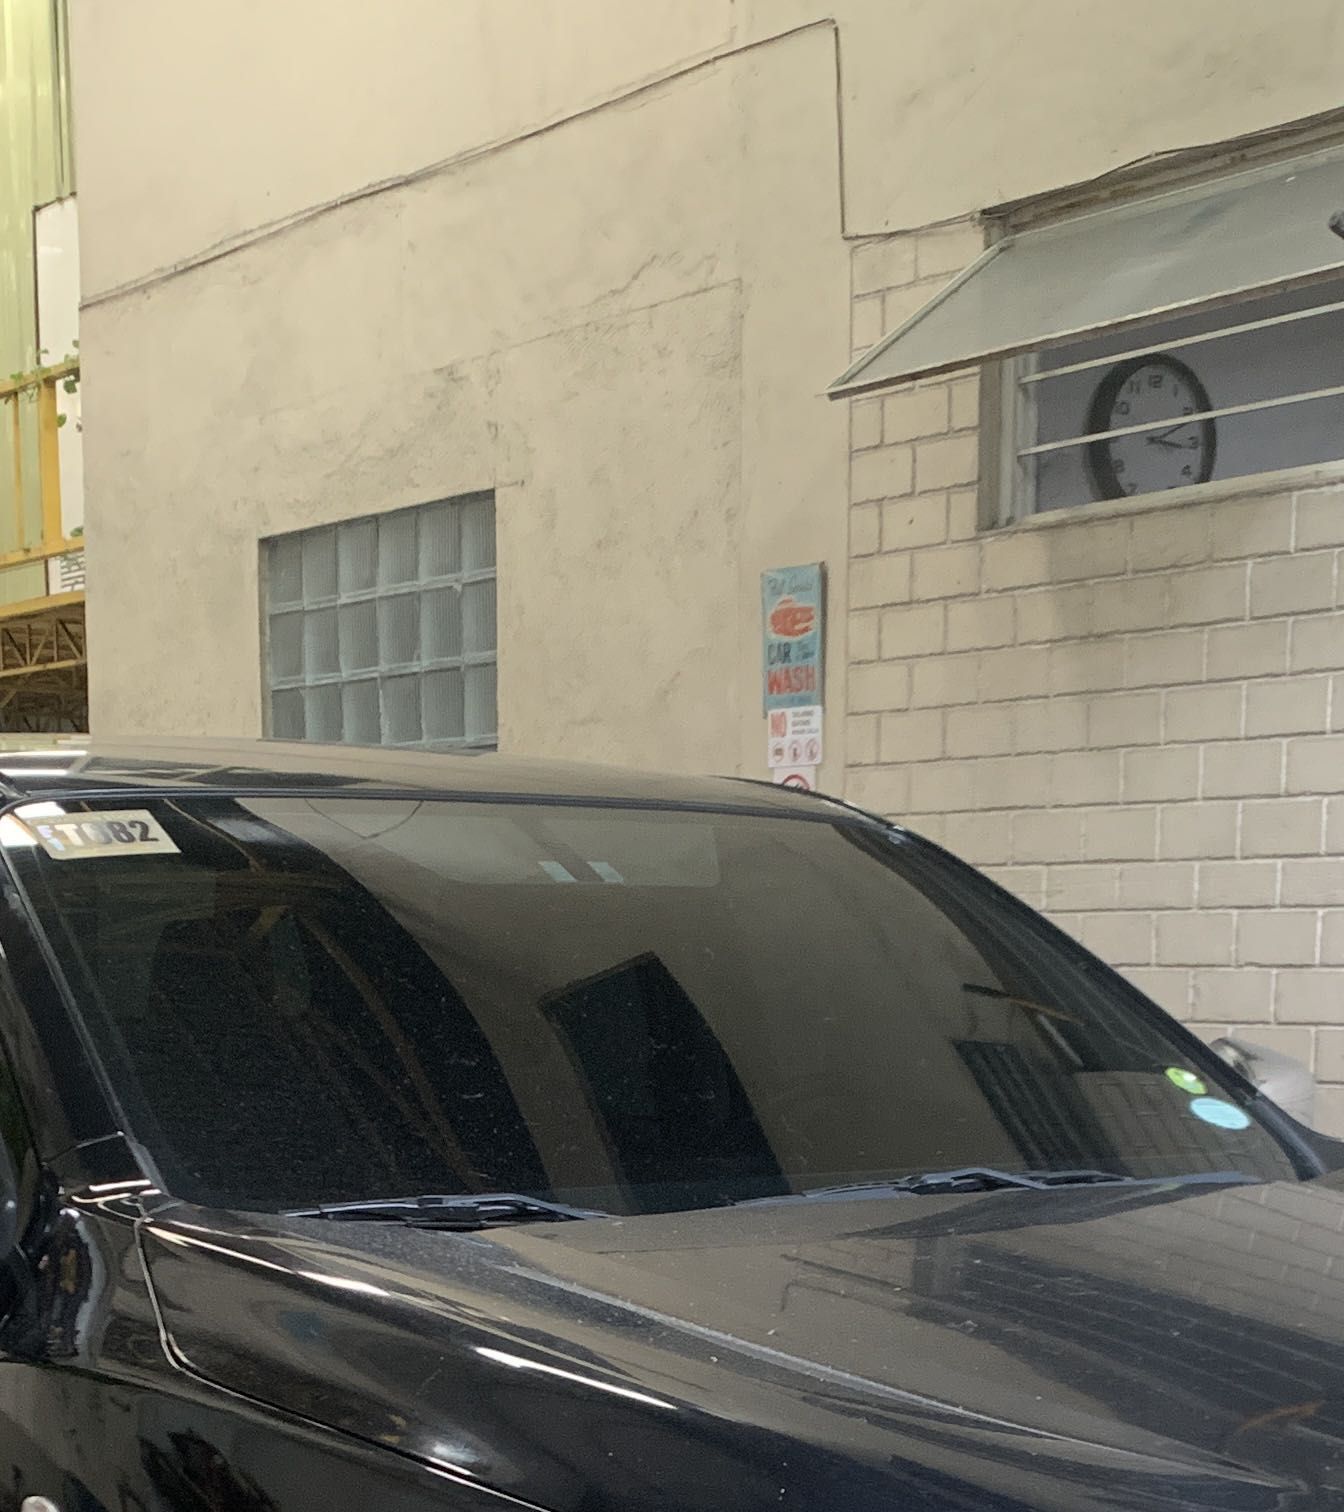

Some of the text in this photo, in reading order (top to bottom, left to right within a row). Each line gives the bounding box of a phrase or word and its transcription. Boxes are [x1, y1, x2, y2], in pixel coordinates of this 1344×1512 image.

[768, 641, 792, 665] CAR
[768, 664, 817, 695] WASH
[770, 710, 788, 738] NO
